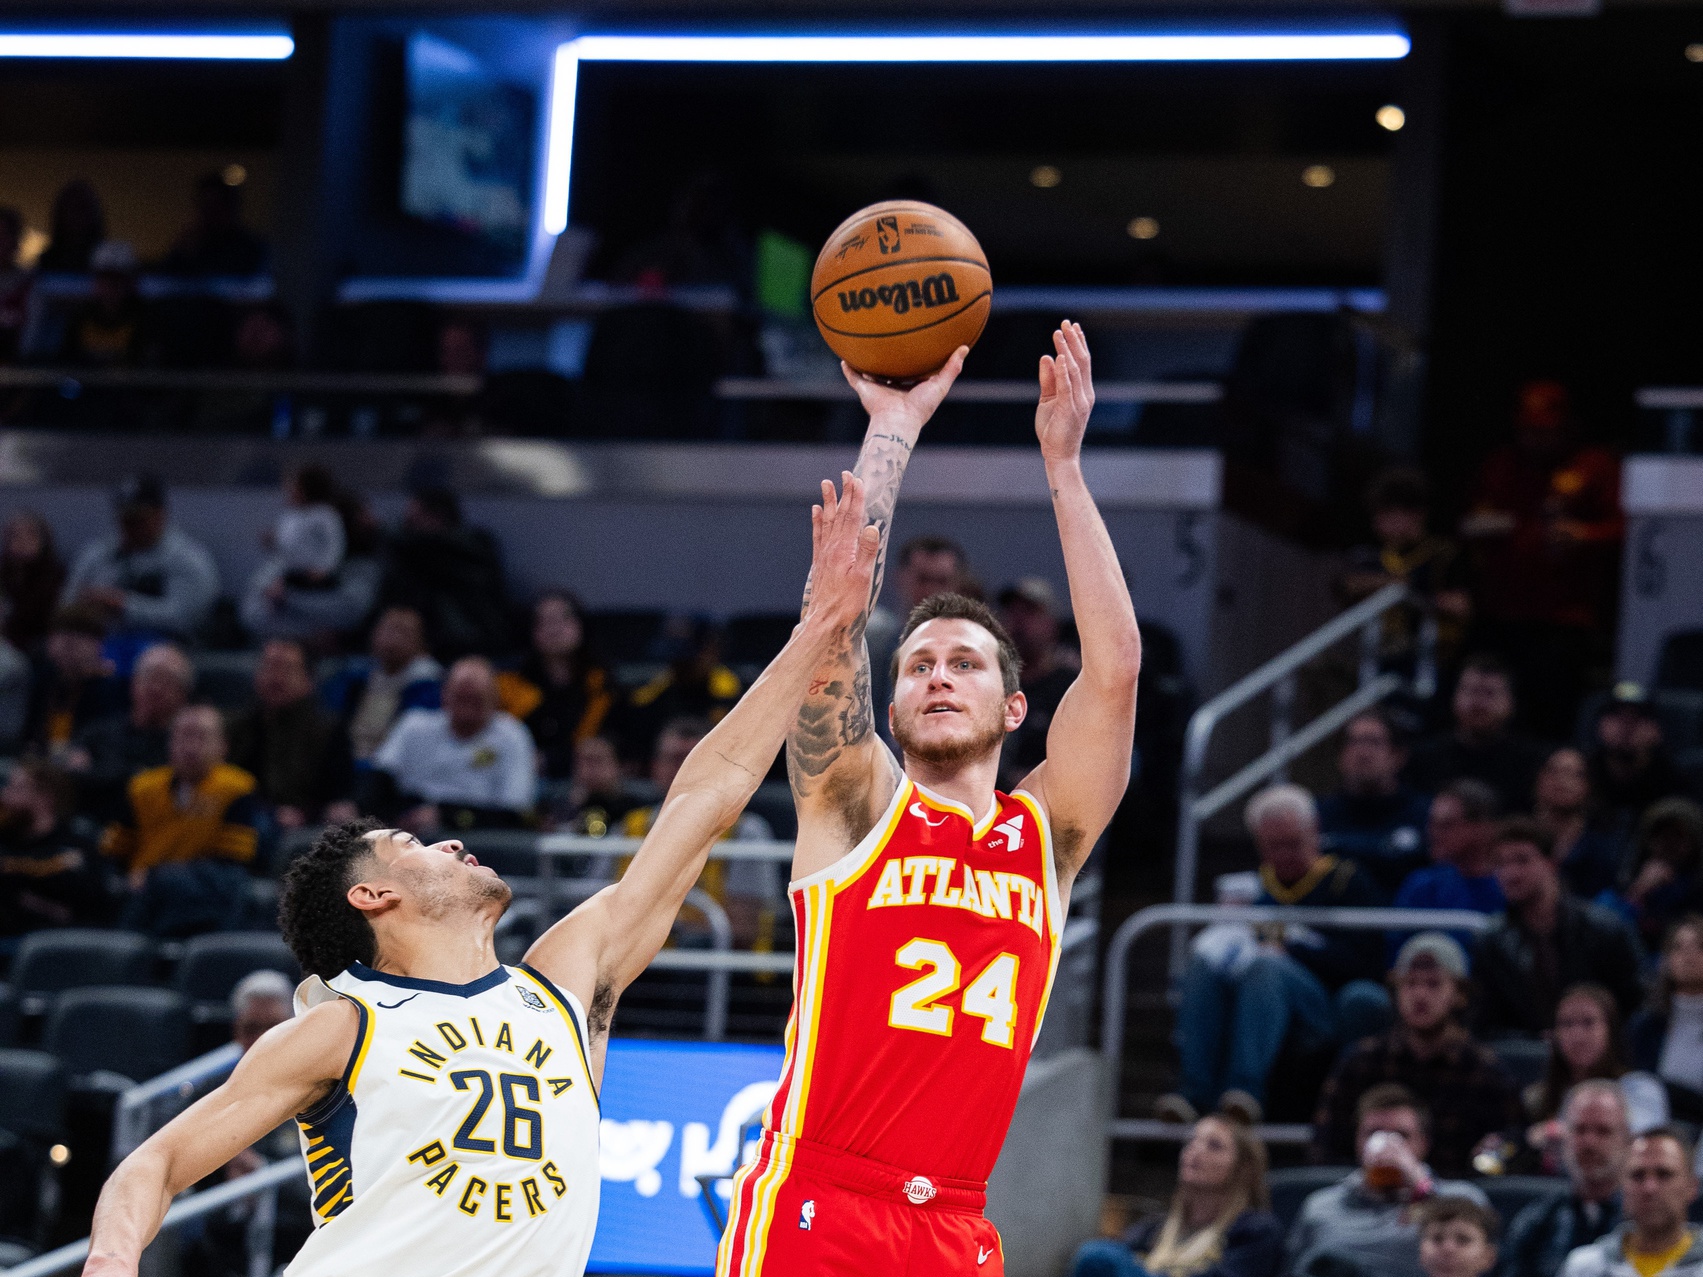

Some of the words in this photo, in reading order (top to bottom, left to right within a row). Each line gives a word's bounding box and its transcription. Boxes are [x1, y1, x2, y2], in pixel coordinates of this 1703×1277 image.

[837, 272, 960, 315] Wilson
[988, 838, 1004, 849] the
[887, 937, 1020, 1050] 24
[398, 1016, 575, 1099] INDIANA
[449, 1069, 543, 1161] 26
[406, 1138, 568, 1222] PACERS
[903, 1182, 937, 1198] HAWKS
